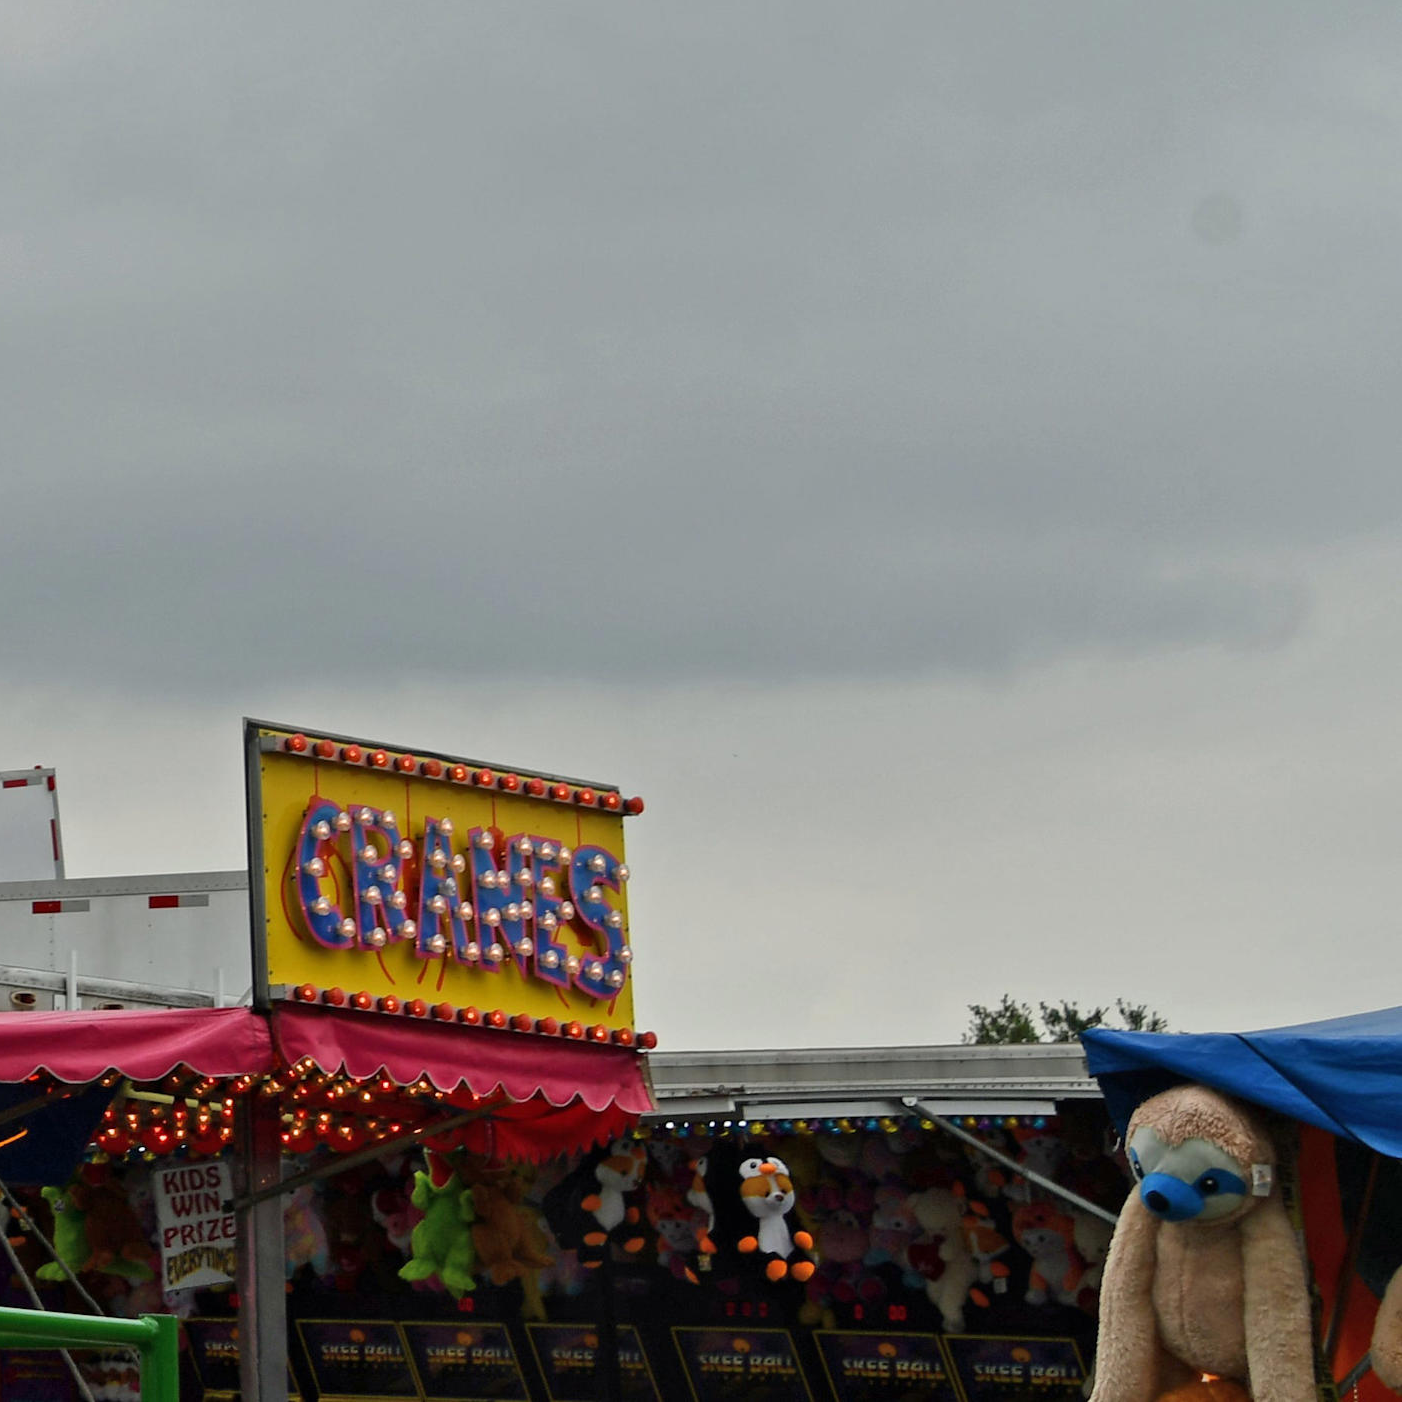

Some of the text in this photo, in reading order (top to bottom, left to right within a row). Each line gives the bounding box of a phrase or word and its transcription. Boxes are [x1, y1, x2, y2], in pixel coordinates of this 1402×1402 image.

[297, 798, 634, 1000] CRANES
[163, 1166, 221, 1194] KIDS
[171, 1191, 221, 1217] WIN
[164, 1216, 236, 1248] PRIZE
[749, 1355, 796, 1374] BALL
[895, 1359, 947, 1380] BALL
[1029, 1365, 1082, 1386] BALL
